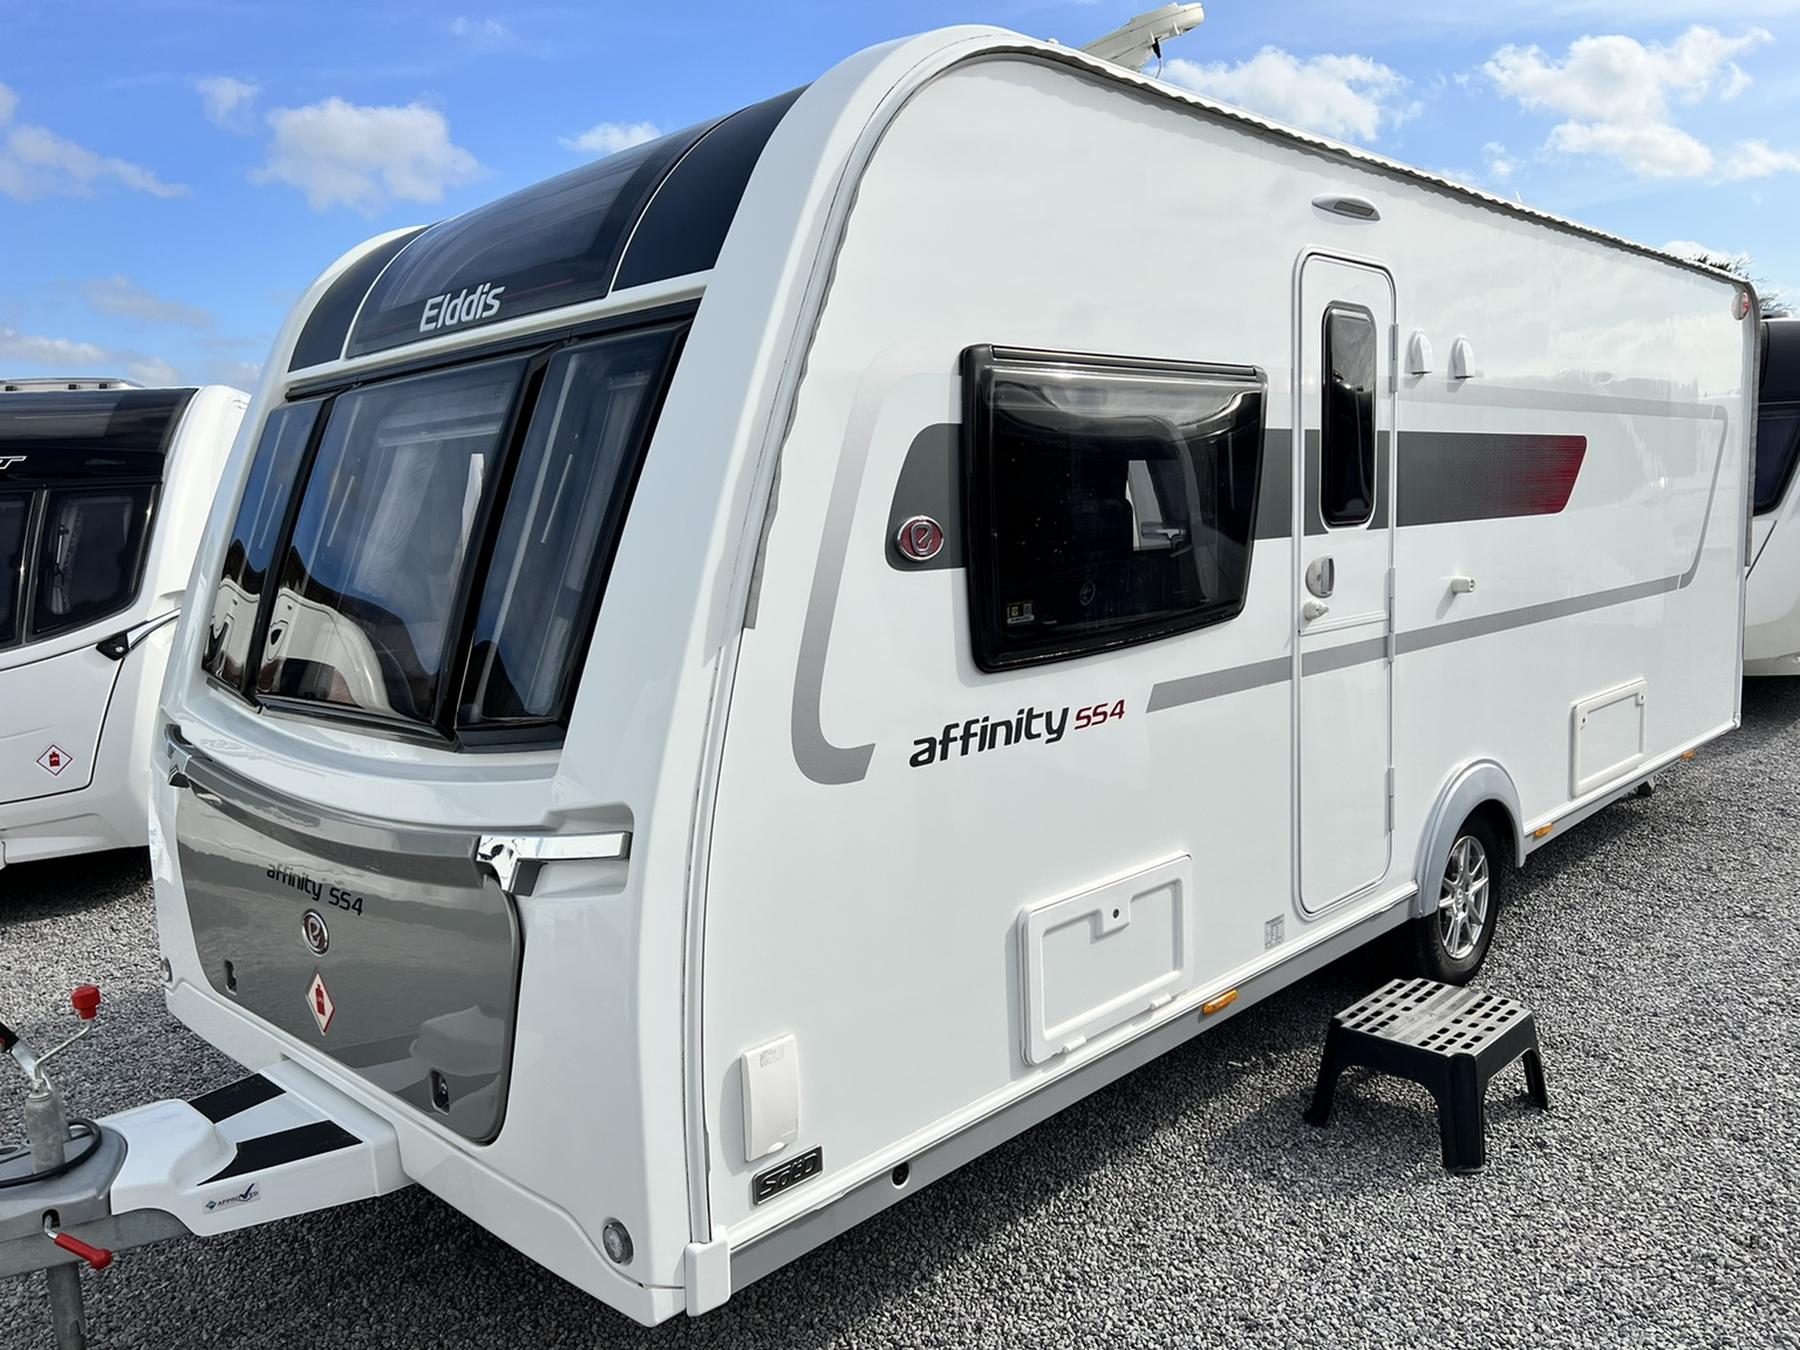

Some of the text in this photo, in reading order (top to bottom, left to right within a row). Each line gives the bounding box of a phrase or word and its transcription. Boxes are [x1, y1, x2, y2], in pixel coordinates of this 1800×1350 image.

[419, 282, 506, 333] Elddis
[908, 706, 1070, 769] affinity
[266, 863, 323, 902] affinity
